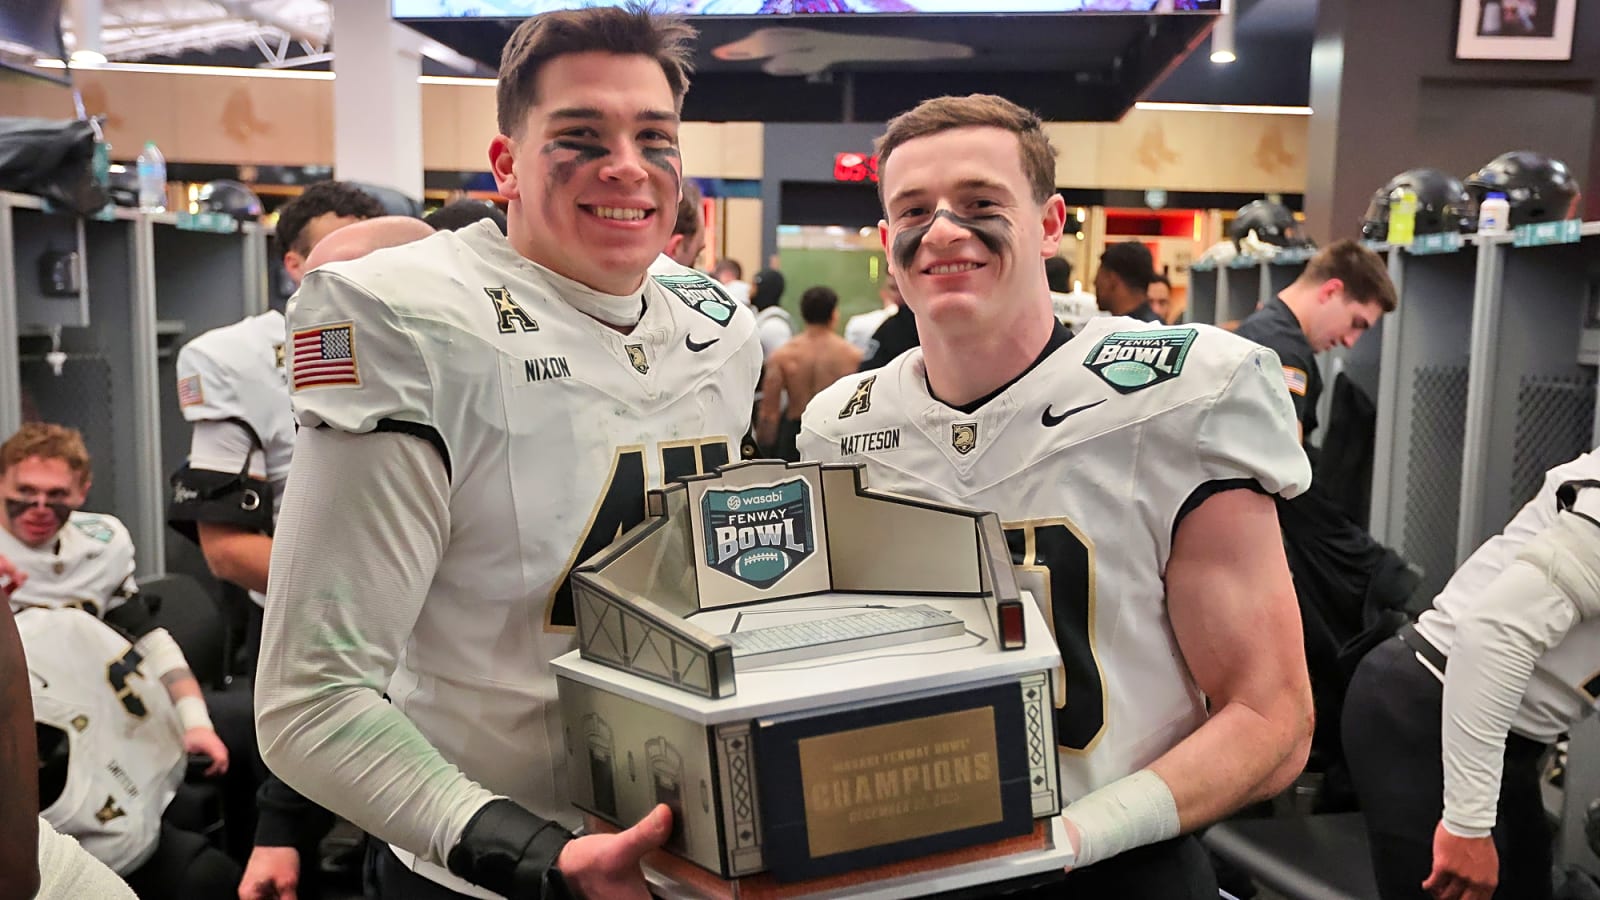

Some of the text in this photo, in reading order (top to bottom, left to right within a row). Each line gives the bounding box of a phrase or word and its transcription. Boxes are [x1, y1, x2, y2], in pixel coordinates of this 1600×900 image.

[1118, 339, 1170, 347] FENWAY
[525, 356, 571, 382] NIXON
[1091, 344, 1173, 374] BOWL
[840, 428, 900, 456] MATTESON
[742, 490, 783, 505] wasabi
[728, 508, 787, 525] FENWAY
[714, 518, 805, 564] BOWL
[811, 752, 992, 811] CHAMPIONS
